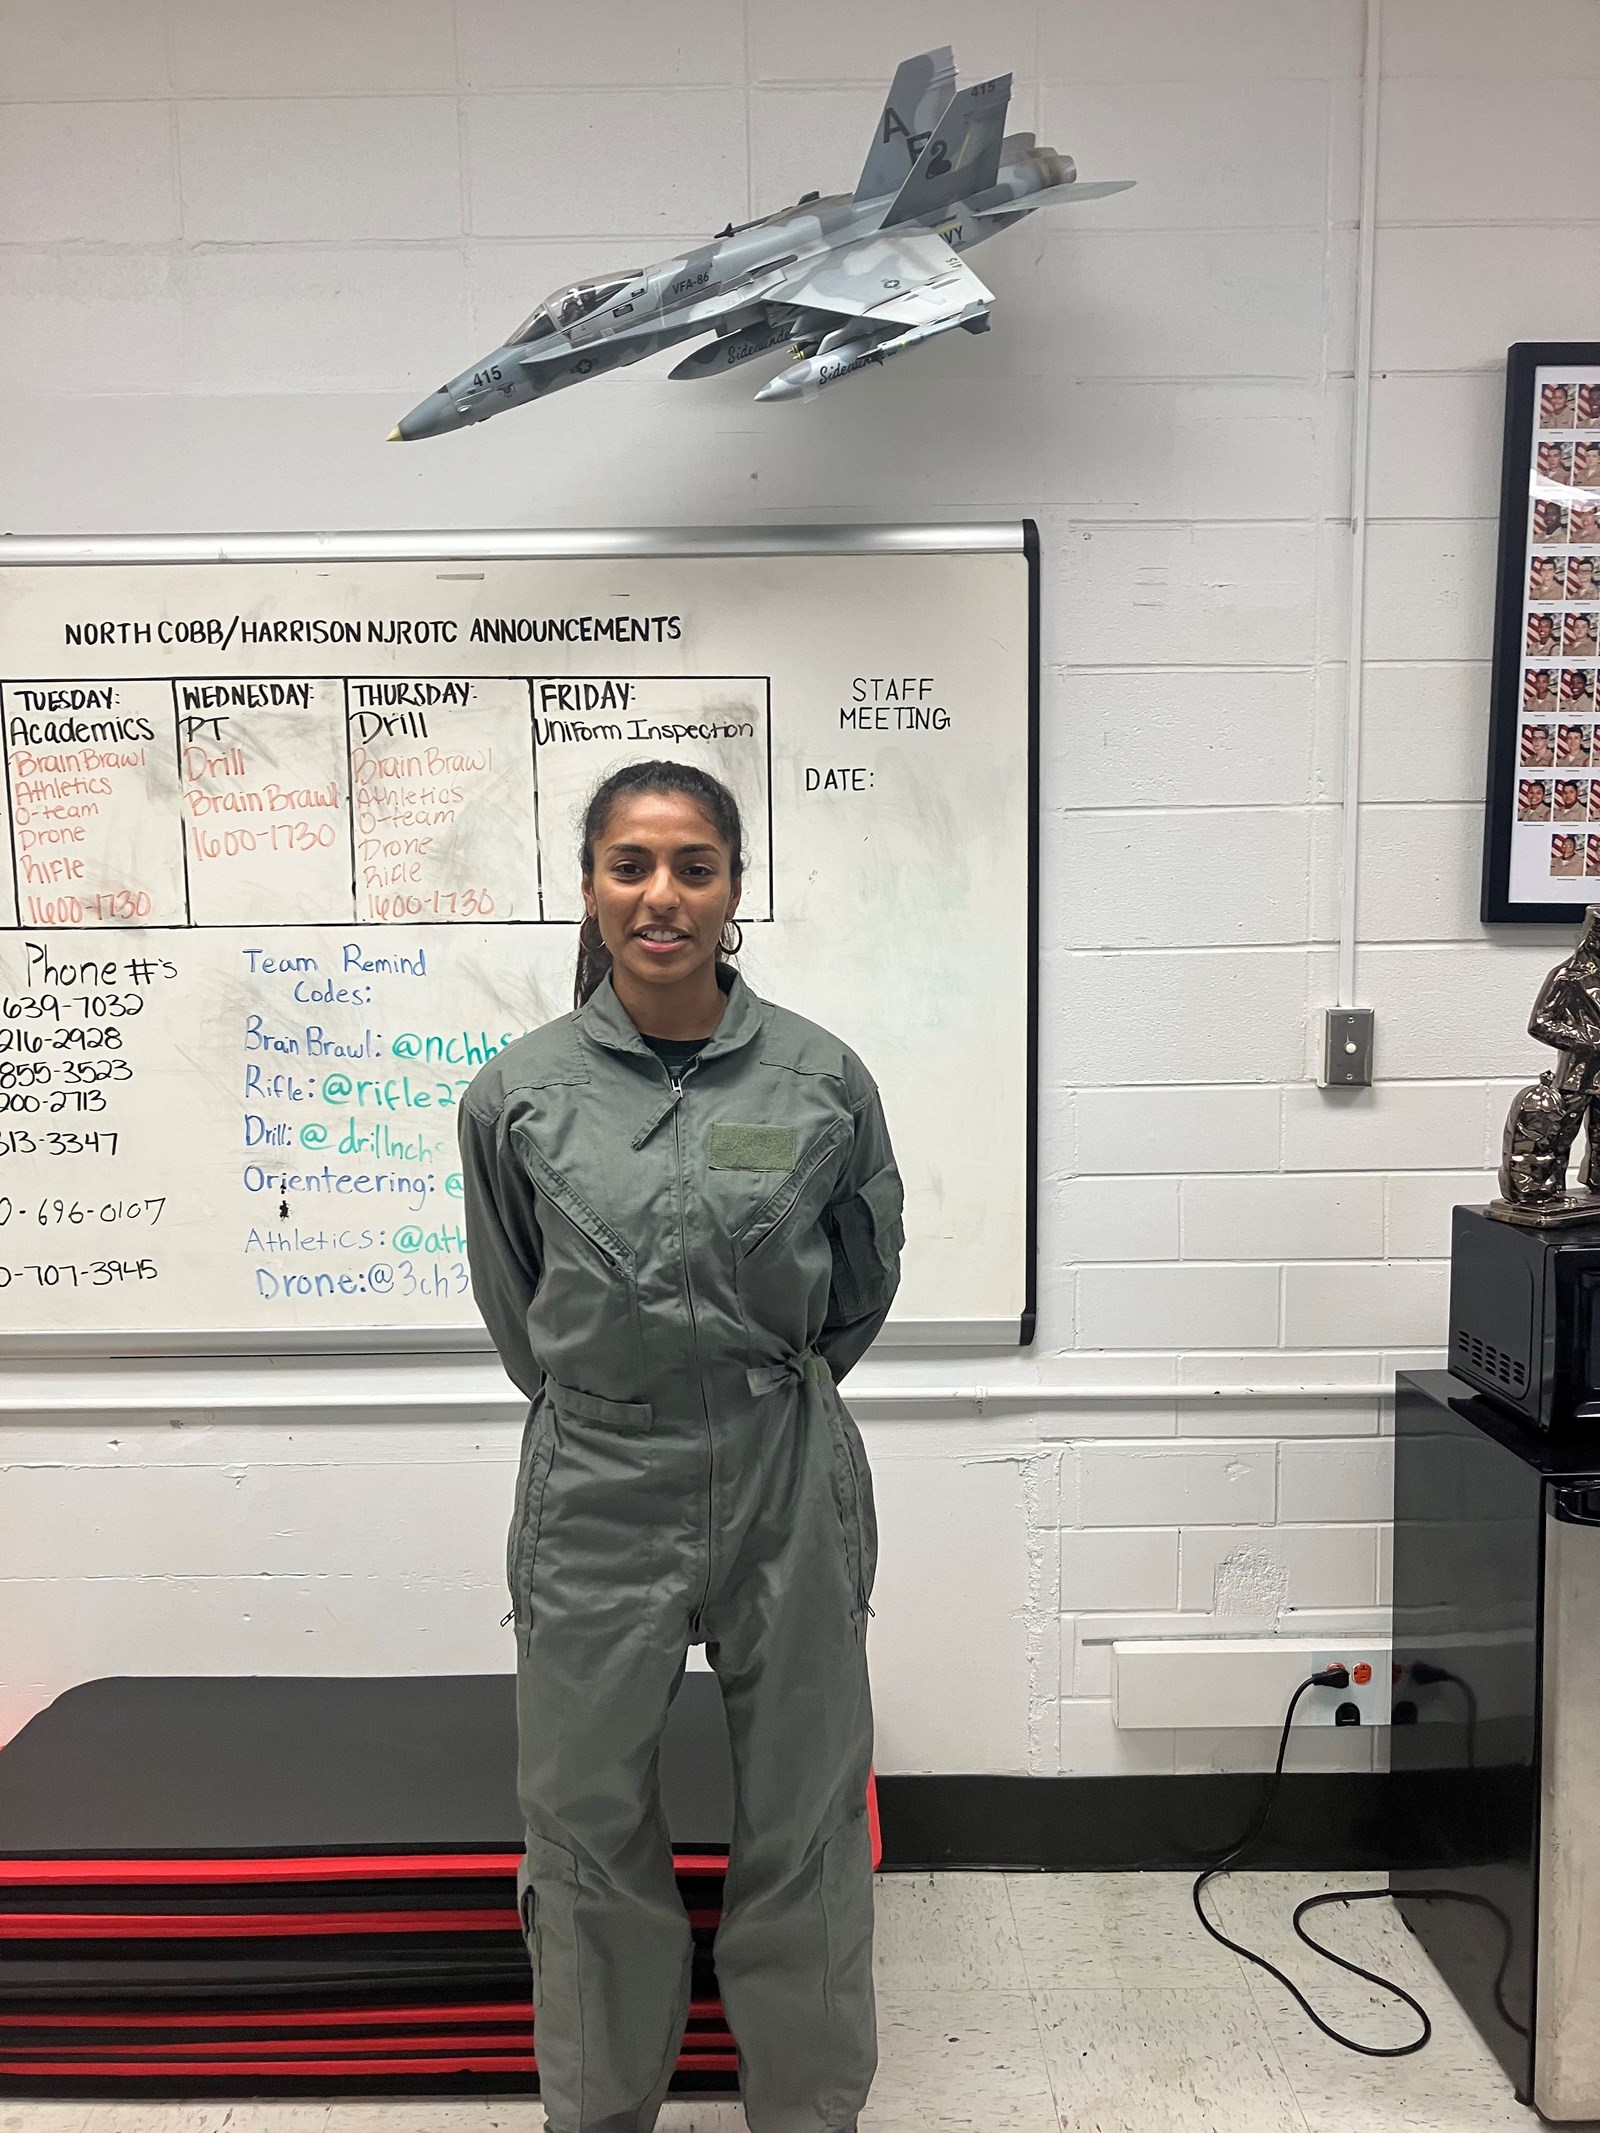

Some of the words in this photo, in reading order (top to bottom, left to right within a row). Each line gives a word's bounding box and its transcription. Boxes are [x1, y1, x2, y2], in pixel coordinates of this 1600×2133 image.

[672, 271, 710, 295] VFA-86
[473, 365, 502, 387] 415
[65, 622, 151, 645] NORTH
[367, 619, 458, 645] NJROTC
[470, 615, 682, 643] ANNOUNCEMENTS
[13, 687, 120, 711] TUESDAY:
[183, 683, 314, 710] WEDNESDAY:
[352, 681, 477, 707] THURSDAY:
[541, 681, 636, 712] FRIDAY:
[852, 677, 934, 701] STAFF
[10, 717, 155, 747] Academics
[179, 716, 230, 742] PT
[349, 711, 428, 745] Drill
[626, 718, 754, 744] Inspection
[840, 707, 950, 730] MEETING
[183, 746, 245, 782] Drill
[15, 777, 113, 806] Athletics
[805, 767, 874, 791] DATE:
[18, 826, 86, 851] Drone
[192, 821, 336, 861] 1600-1730
[358, 837, 434, 862] Drone
[27, 890, 151, 925] 1600-1730
[25, 942, 117, 987] Phone
[242, 948, 318, 974] Team
[343, 943, 427, 977] Remind
[294, 978, 372, 1004] Codes:
[2, 993, 144, 1022] 639-7032
[392, 1031, 528, 1066] @nchh
[0, 1060, 134, 1089] 855-3523
[244, 1063, 316, 1102] Rifle:
[244, 1114, 292, 1147] Drill:
[243, 1165, 436, 1212] Orienteering:
[245, 1228, 386, 1254] Athletics:
